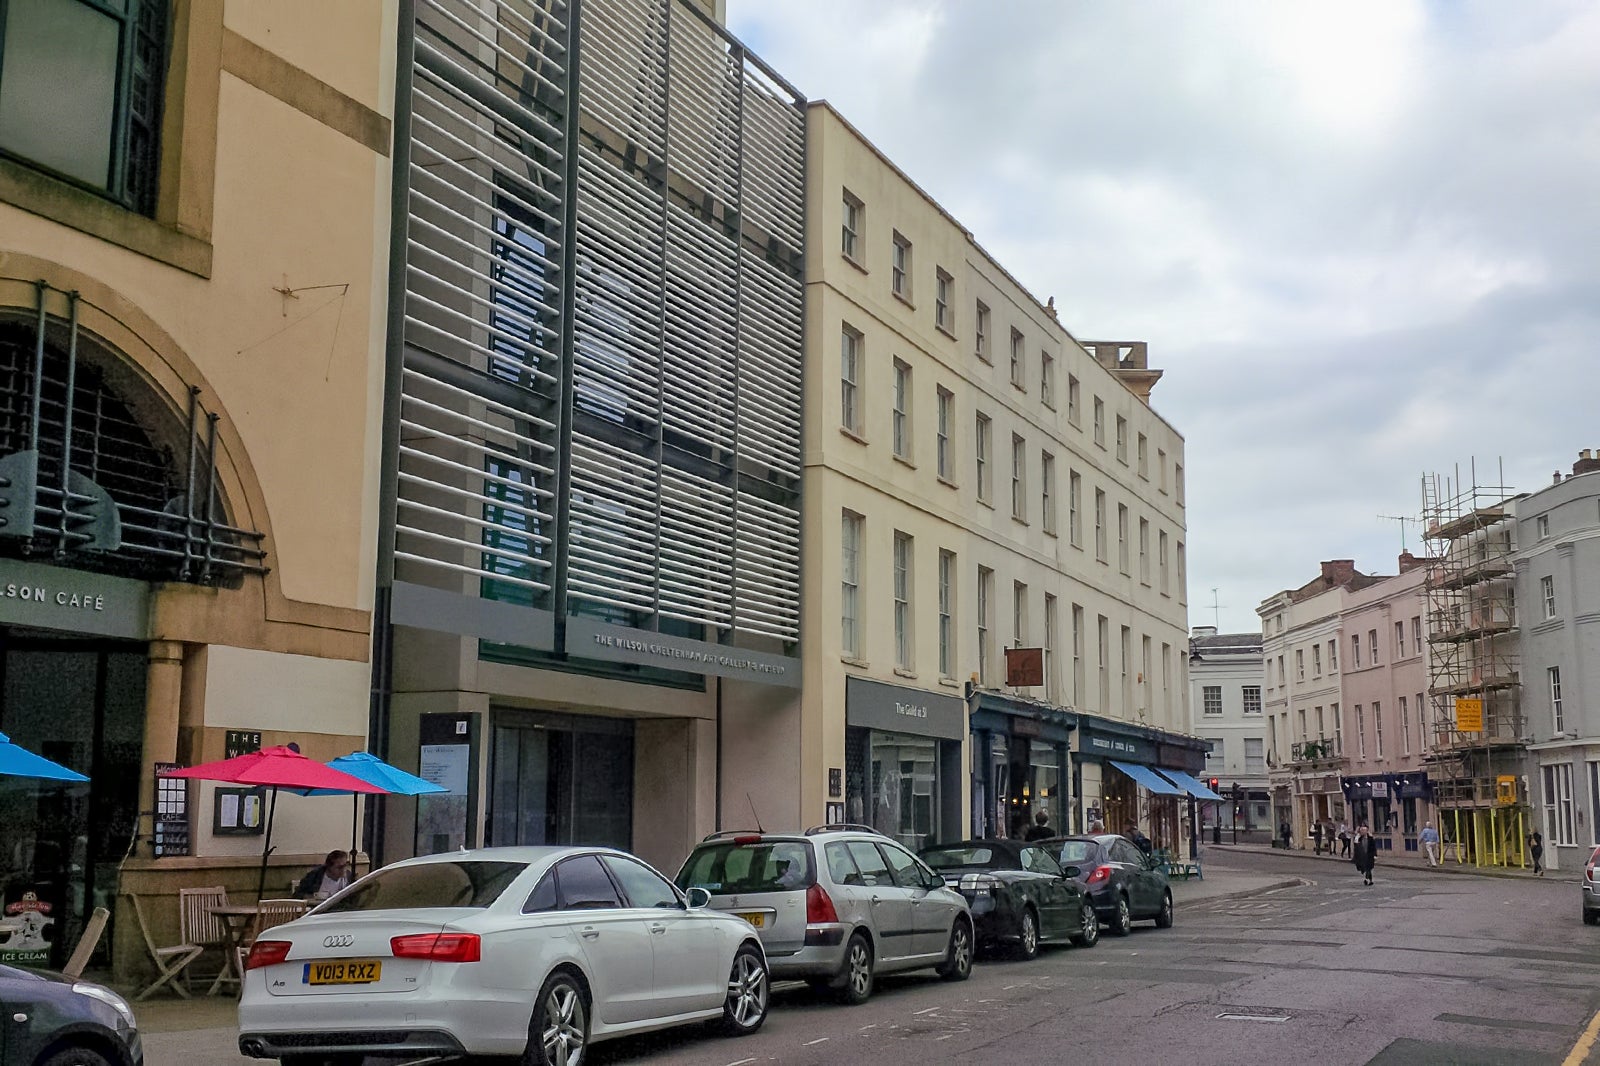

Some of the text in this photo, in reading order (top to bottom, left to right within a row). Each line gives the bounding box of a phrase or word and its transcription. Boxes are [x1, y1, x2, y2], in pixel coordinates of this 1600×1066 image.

[56, 592, 104, 610] CAFÉ
[595, 634, 612, 646] THE
[616, 638, 648, 652] WILSON
[650, 644, 701, 660] CHELTENHAM
[703, 653, 718, 663] ART
[719, 656, 751, 669] GALLERY
[231, 733, 259, 744] THE
[2, 953, 16, 961] ICE
[348, 963, 375, 979] RXZ
